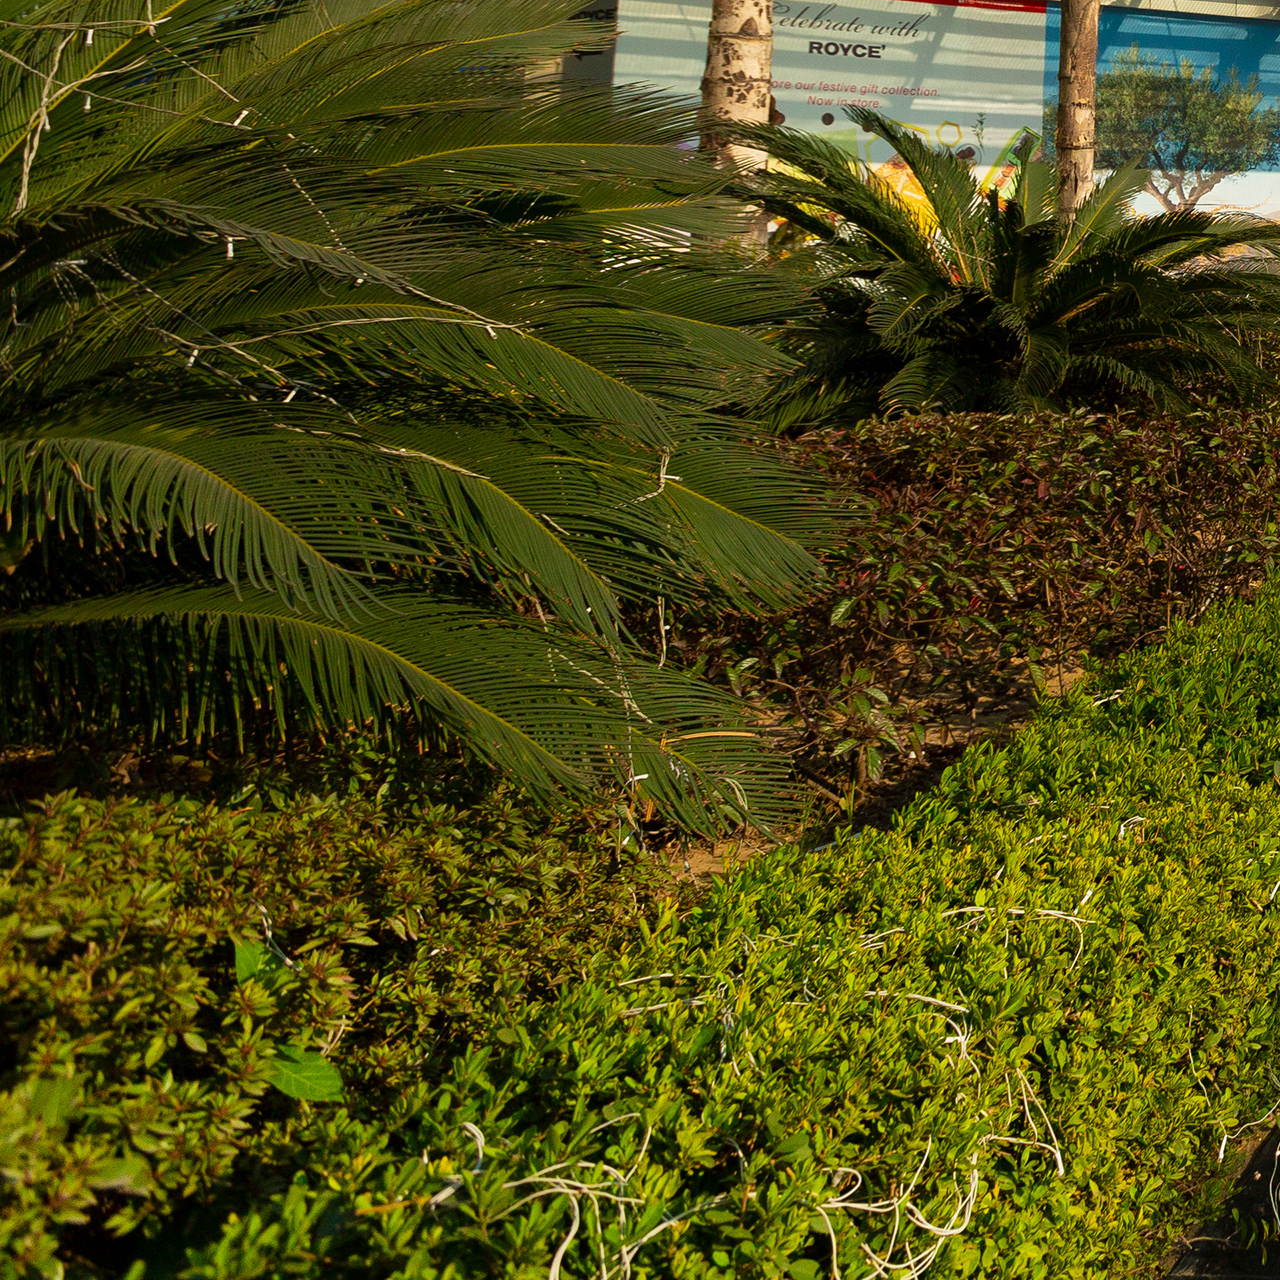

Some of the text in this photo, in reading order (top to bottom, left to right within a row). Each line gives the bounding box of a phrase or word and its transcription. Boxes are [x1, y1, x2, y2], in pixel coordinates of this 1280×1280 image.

[769, 1, 931, 38] Celebrate with
[808, 41, 886, 58] ROYCE'
[794, 81, 816, 91] our
[818, 81, 857, 93] festive
[859, 84, 879, 96] gift
[881, 87, 940, 97] collection.
[806, 95, 883, 109] Now in store.
